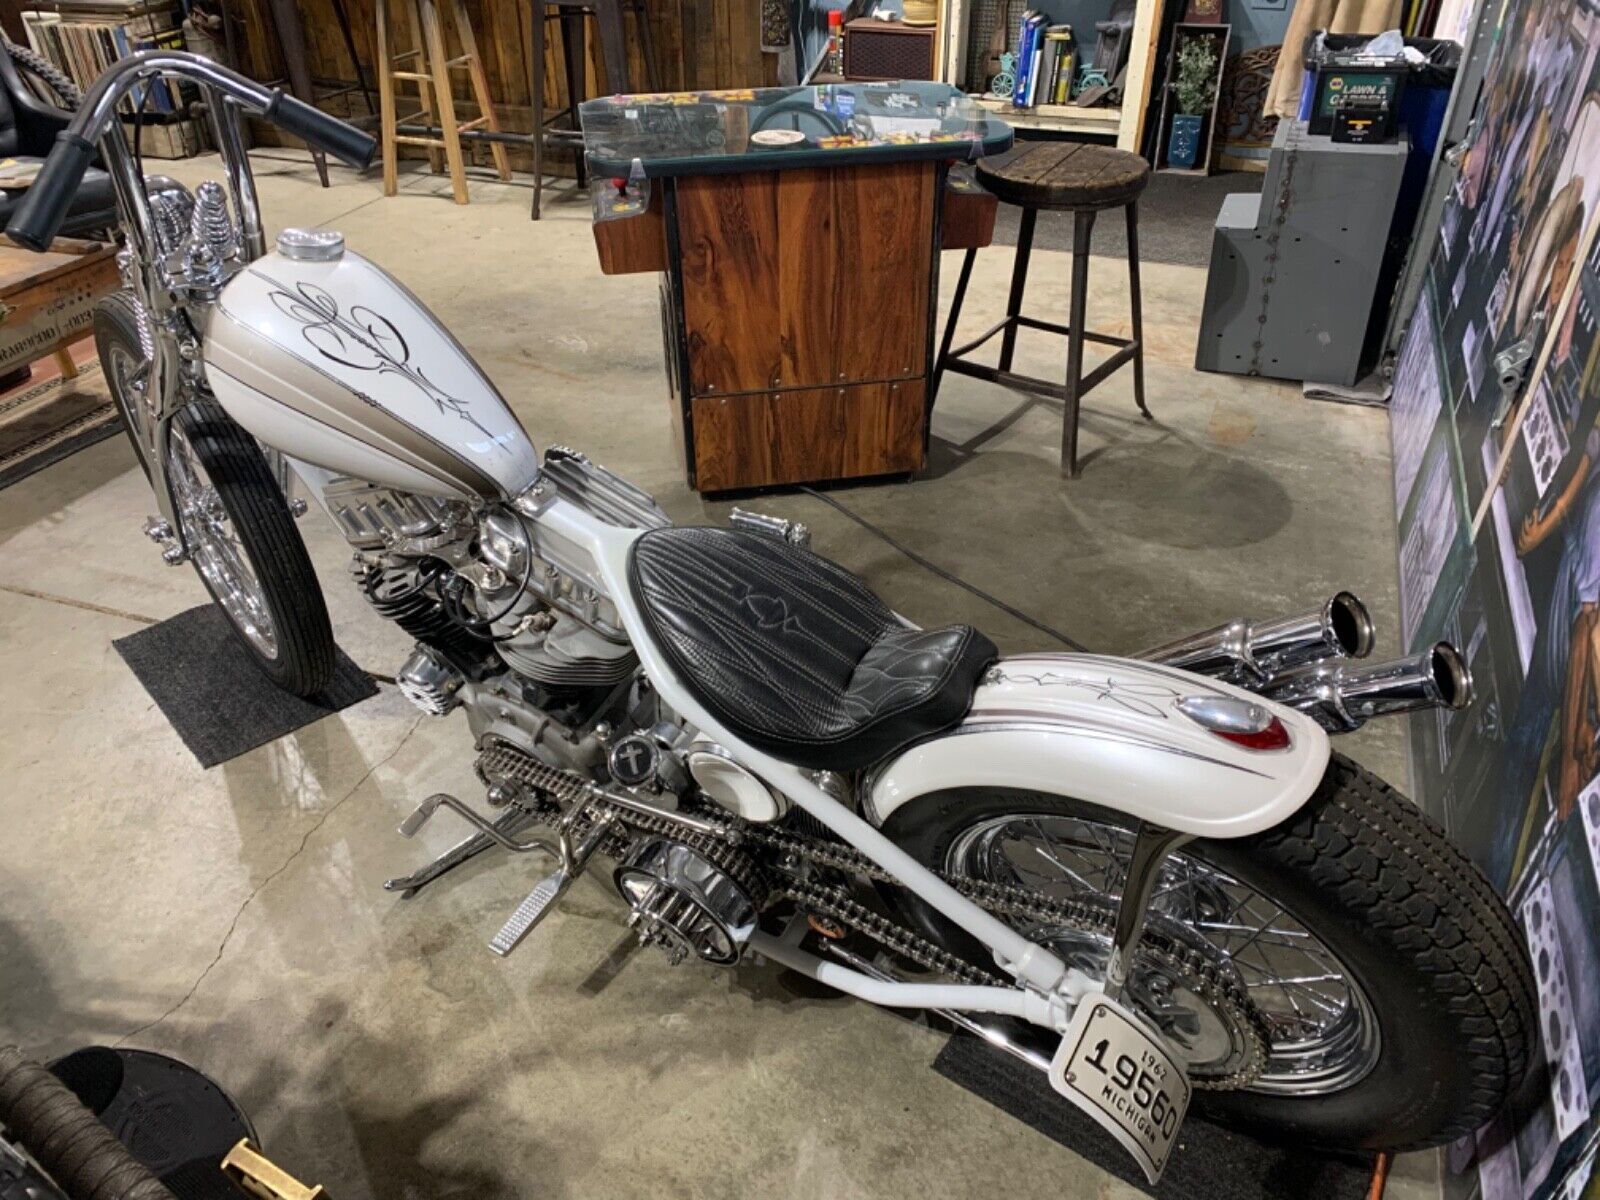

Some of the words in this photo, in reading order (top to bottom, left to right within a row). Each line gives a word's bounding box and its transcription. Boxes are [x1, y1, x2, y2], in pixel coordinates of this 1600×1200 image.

[1342, 85, 1377, 95] LAWN
[1140, 1050, 1168, 1081] 1962
[1084, 1039, 1178, 1141] 19560
[1101, 1084, 1156, 1145] MICHIGAN
